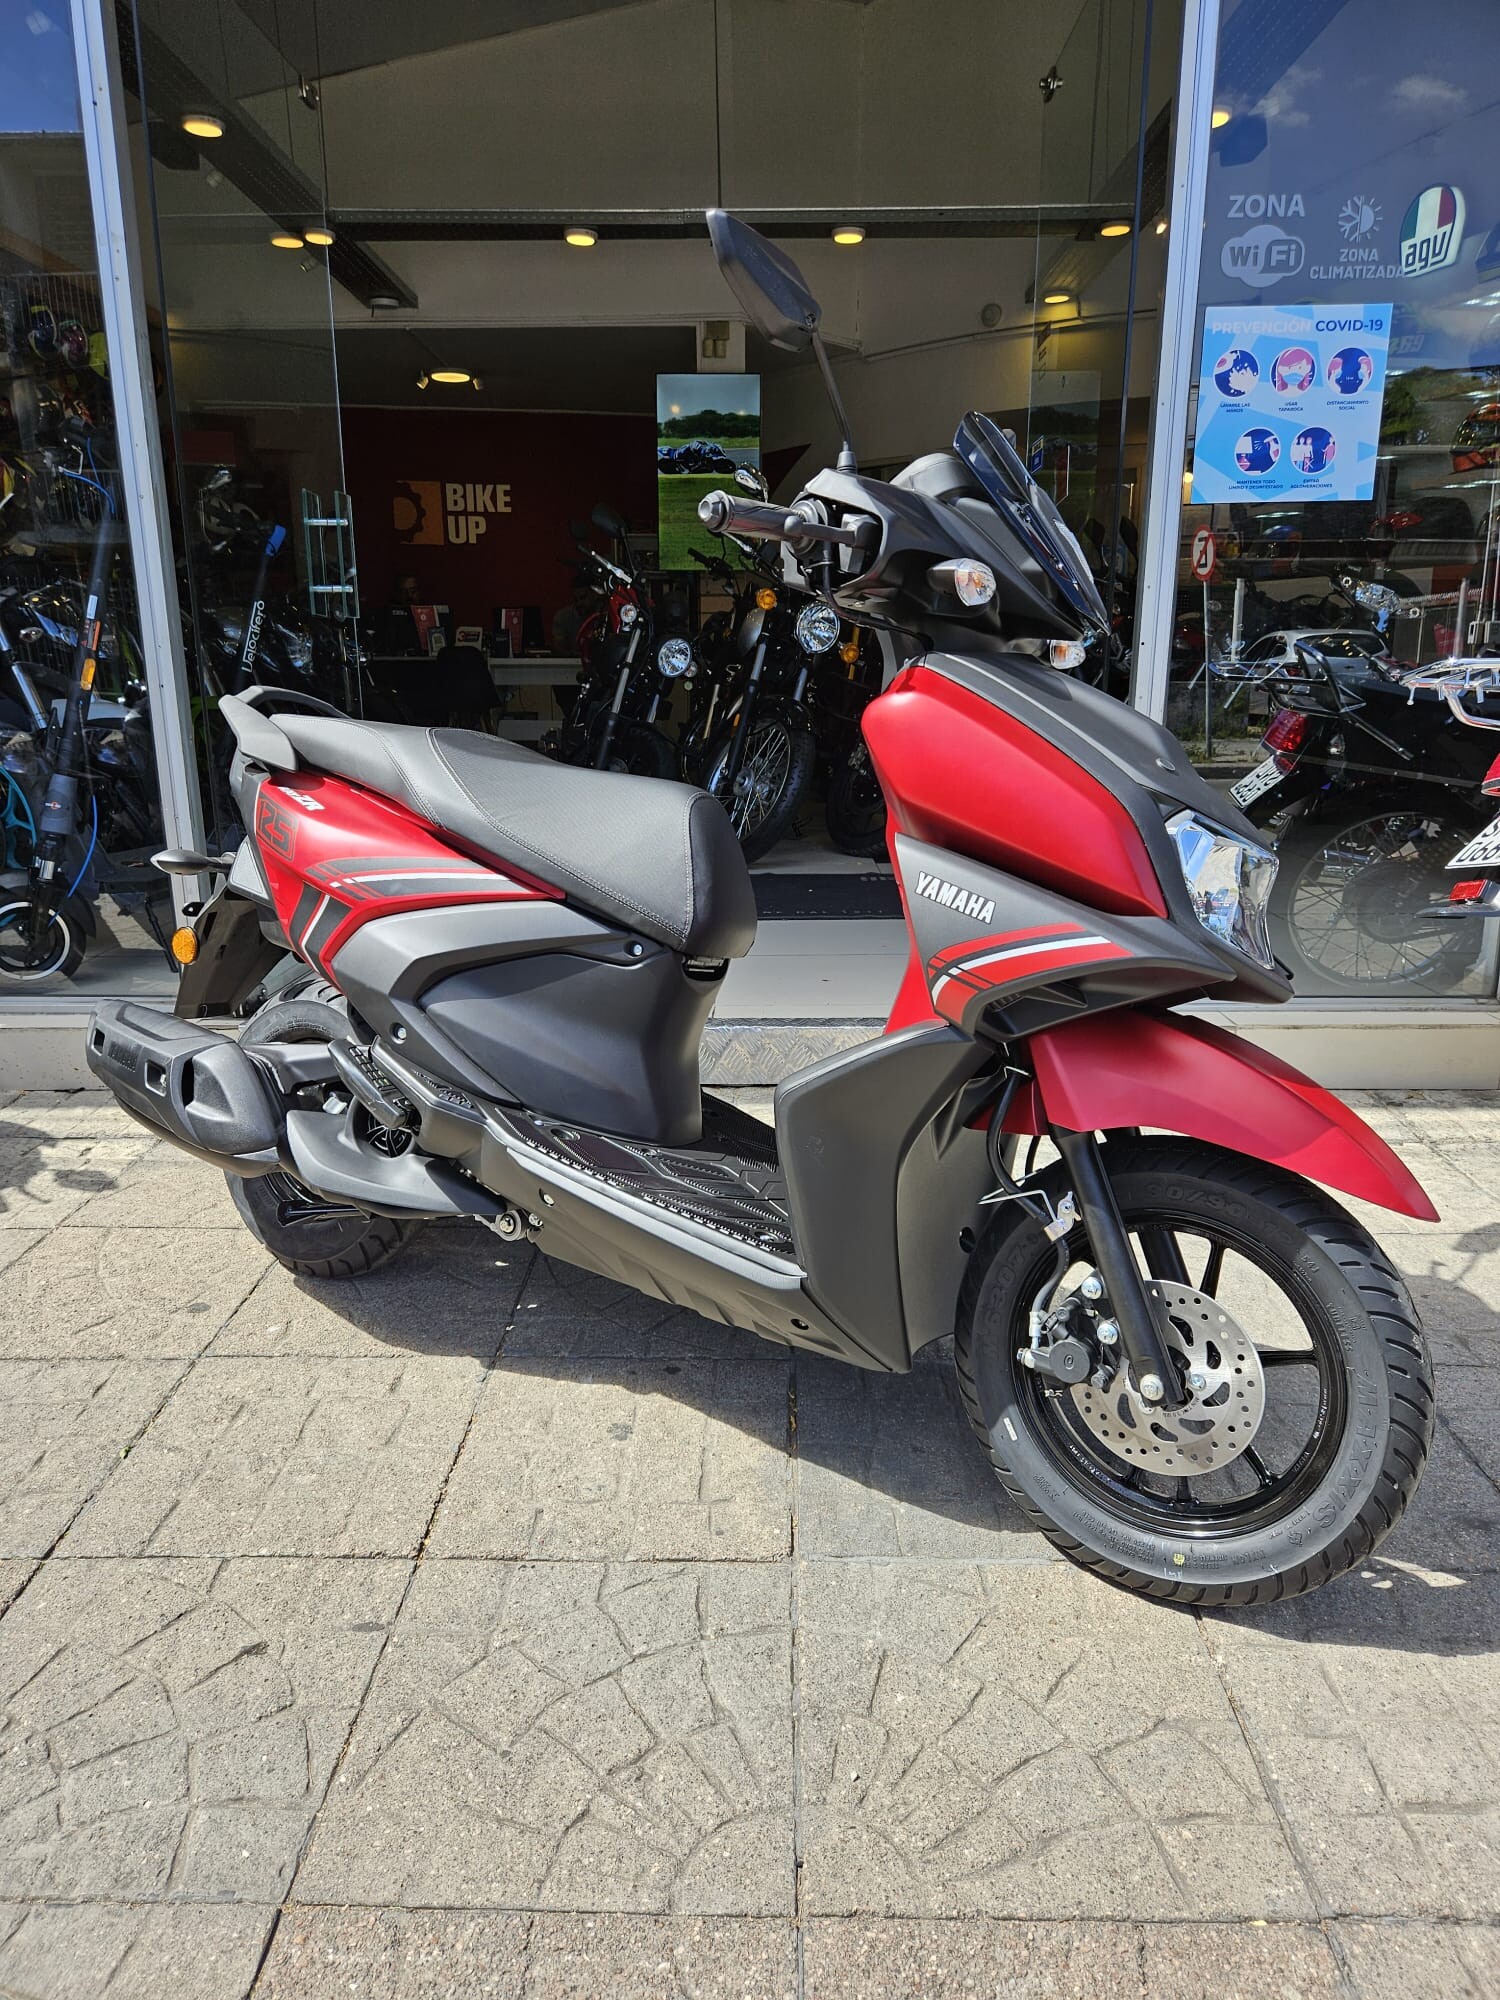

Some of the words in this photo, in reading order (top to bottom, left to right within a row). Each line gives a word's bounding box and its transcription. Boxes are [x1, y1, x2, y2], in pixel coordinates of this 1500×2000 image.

[1227, 194, 1305, 218] ZONA
[1339, 248, 1379, 263] ZONA
[1404, 230, 1448, 271] agv
[1309, 265, 1405, 280] CLIMATIZADA
[1212, 320, 1312, 335] PREVENCIÓN
[1315, 319, 1383, 332] COVID-19
[445, 482, 512, 513] BIKE
[447, 515, 487, 544] UP
[241, 600, 265, 673] Velocifero
[915, 870, 996, 925] YAMAHA
